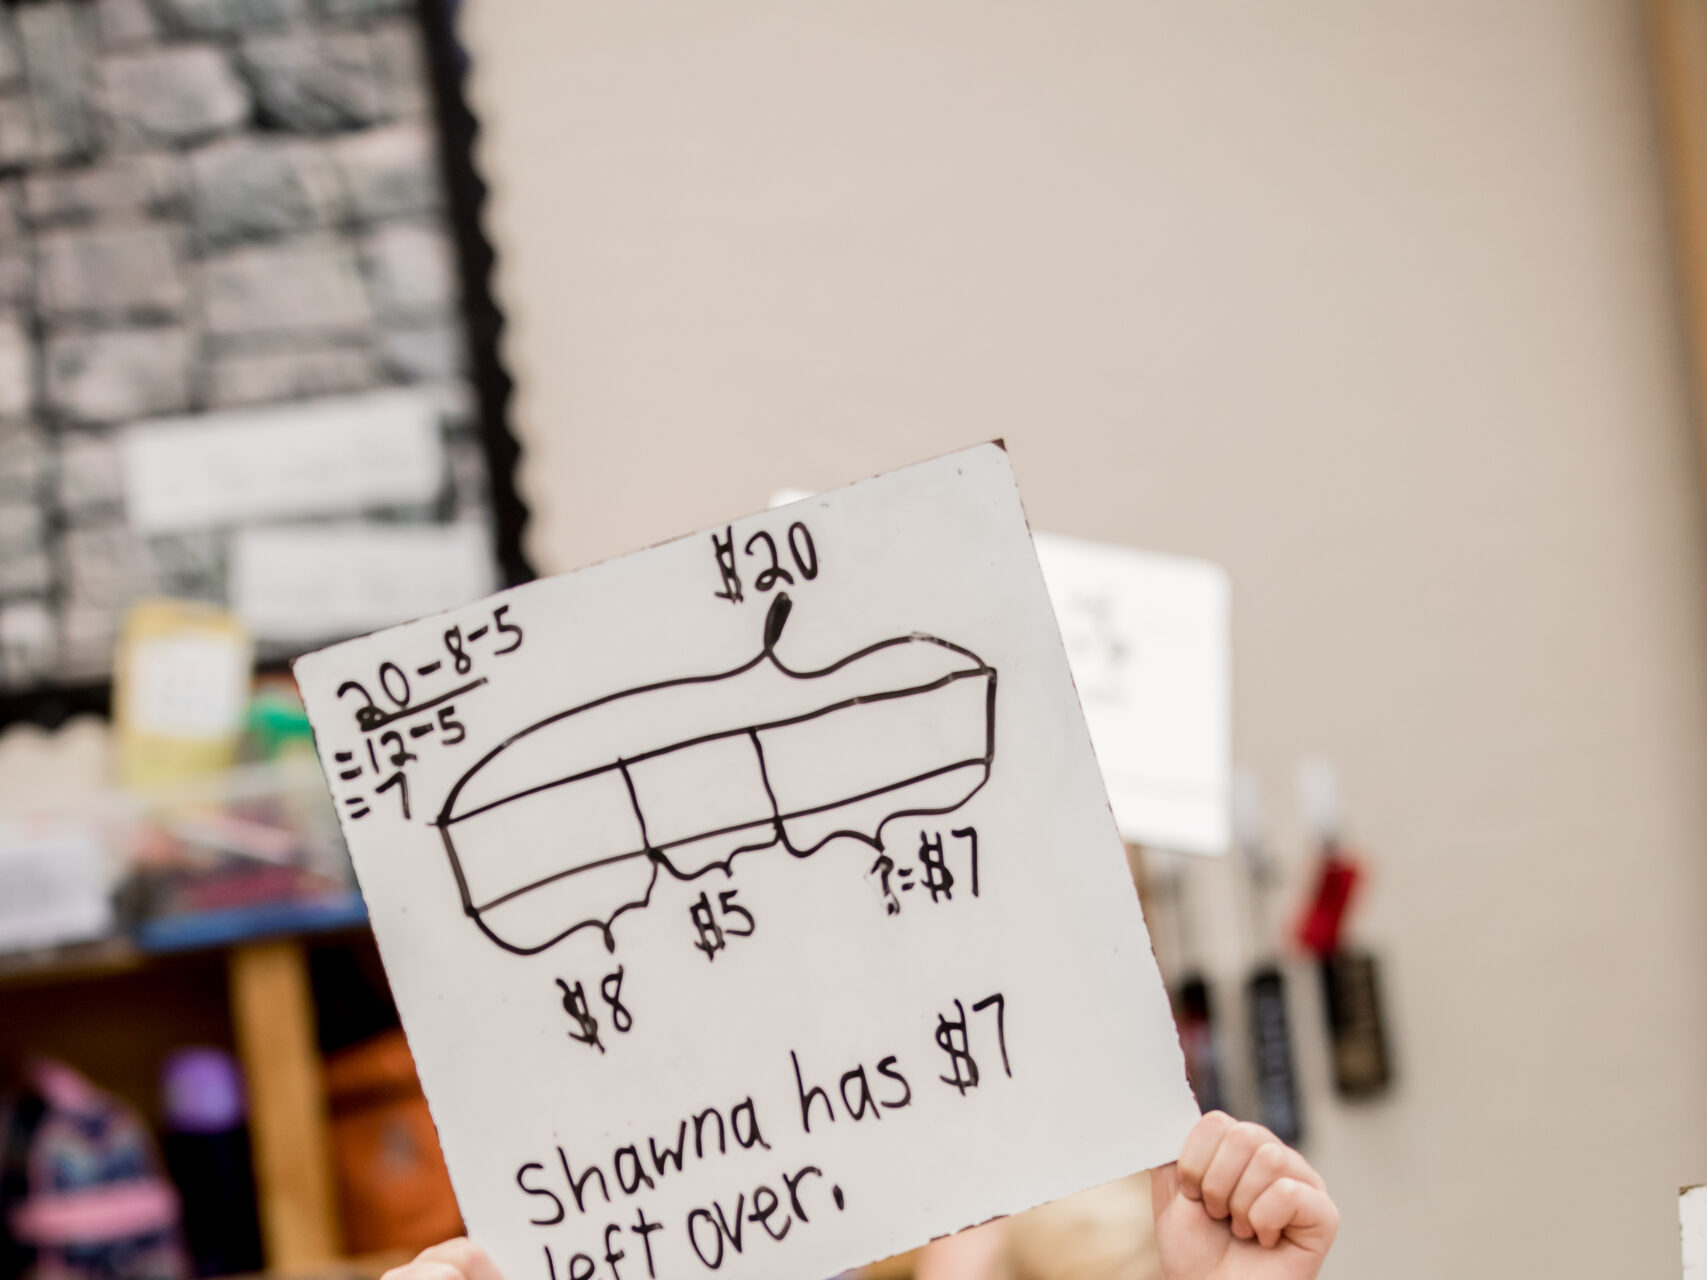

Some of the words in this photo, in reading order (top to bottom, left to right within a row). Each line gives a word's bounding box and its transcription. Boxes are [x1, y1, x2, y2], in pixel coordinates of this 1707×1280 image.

[711, 521, 818, 604] $20
[689, 890, 756, 962] $5
[556, 964, 633, 1055] $8
[516, 1096, 771, 1226] Shawna
[790, 1049, 912, 1133] has
[935, 993, 1013, 1096] $7
[687, 1165, 846, 1270] over.
